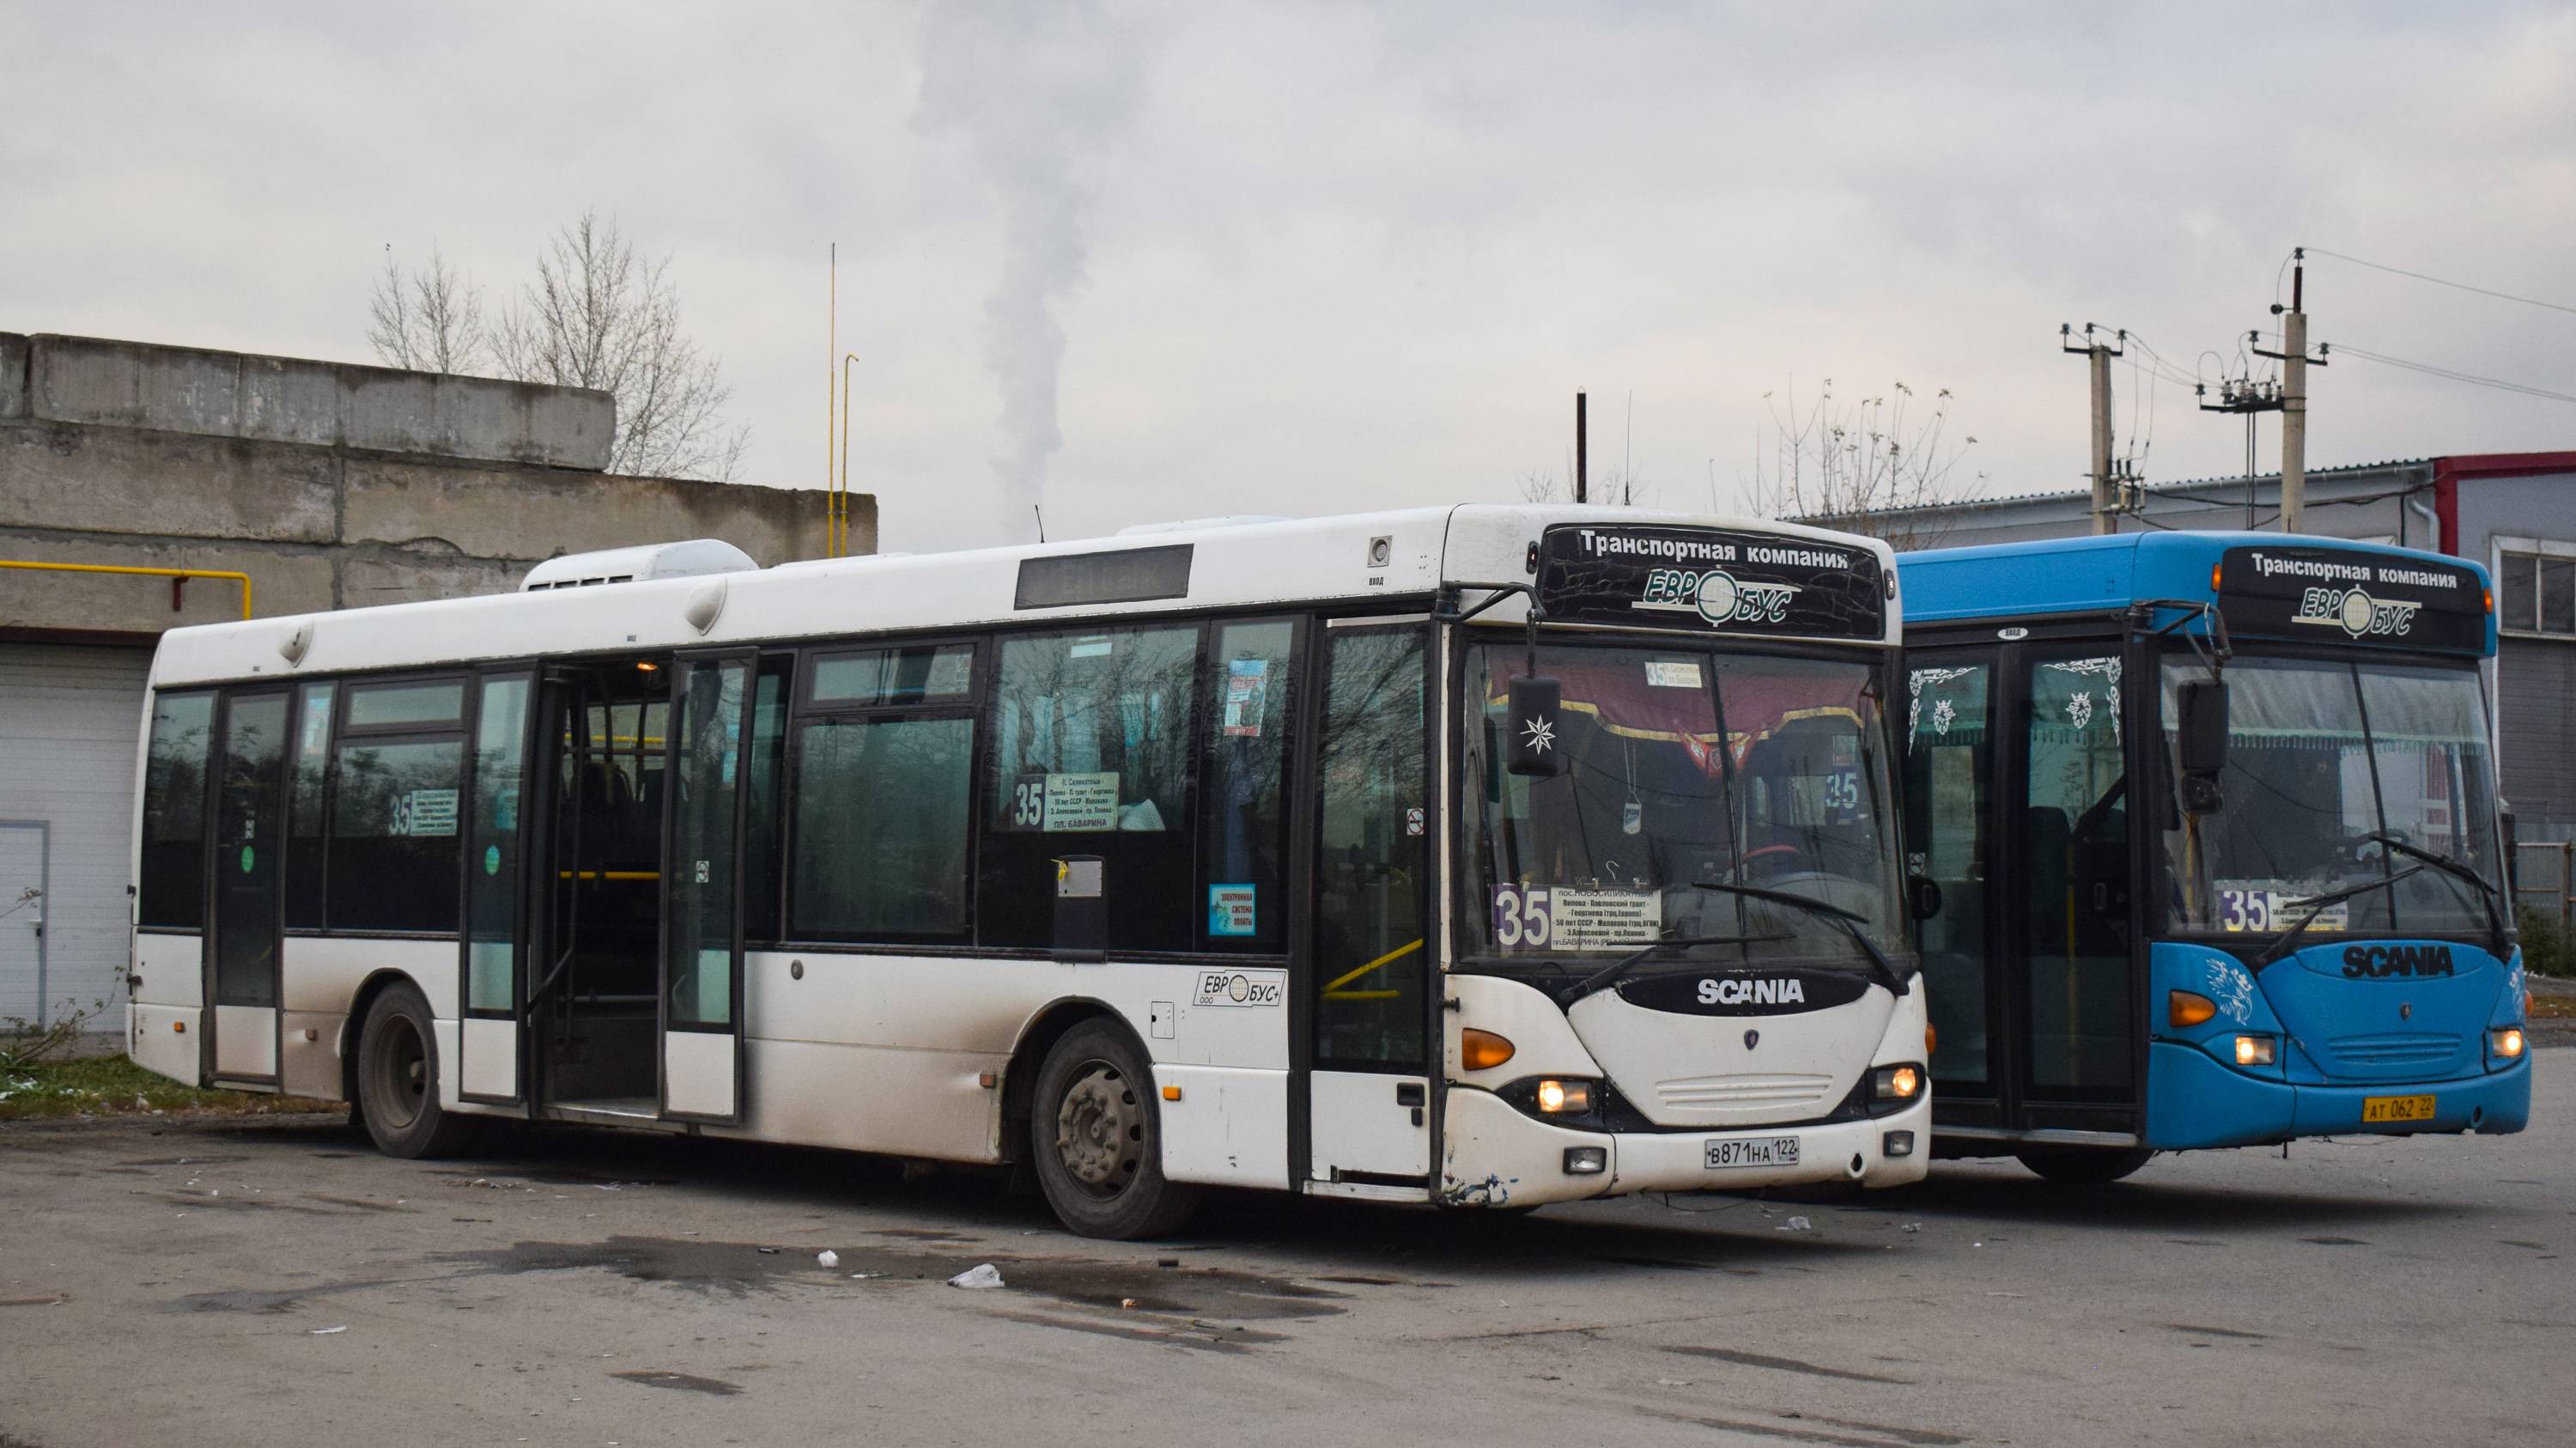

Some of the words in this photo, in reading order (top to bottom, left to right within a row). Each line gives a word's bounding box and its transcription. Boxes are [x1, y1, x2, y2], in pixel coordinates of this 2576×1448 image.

[1580, 530, 1736, 562] Транспортная
[1747, 546, 1849, 569] компания
[1369, 577, 1384, 586] ВХОД
[2251, 553, 2371, 582] Транспортная
[2379, 567, 2457, 589] компания
[1015, 782, 1042, 825] 35
[1826, 772, 1857, 809] 35
[389, 794, 411, 836] 35
[1068, 818, 1108, 828] БАВАРИНА
[1496, 890, 1550, 946] 35
[2224, 890, 2268, 932] 35
[2342, 946, 2455, 978] SCANIA
[1697, 978, 1805, 1004] SCANIA
[2391, 1099, 2414, 1117] 062
[2420, 1098, 2432, 1111] 22
[1711, 1142, 1770, 1164] В871НА
[1774, 1140, 1795, 1155] 122
